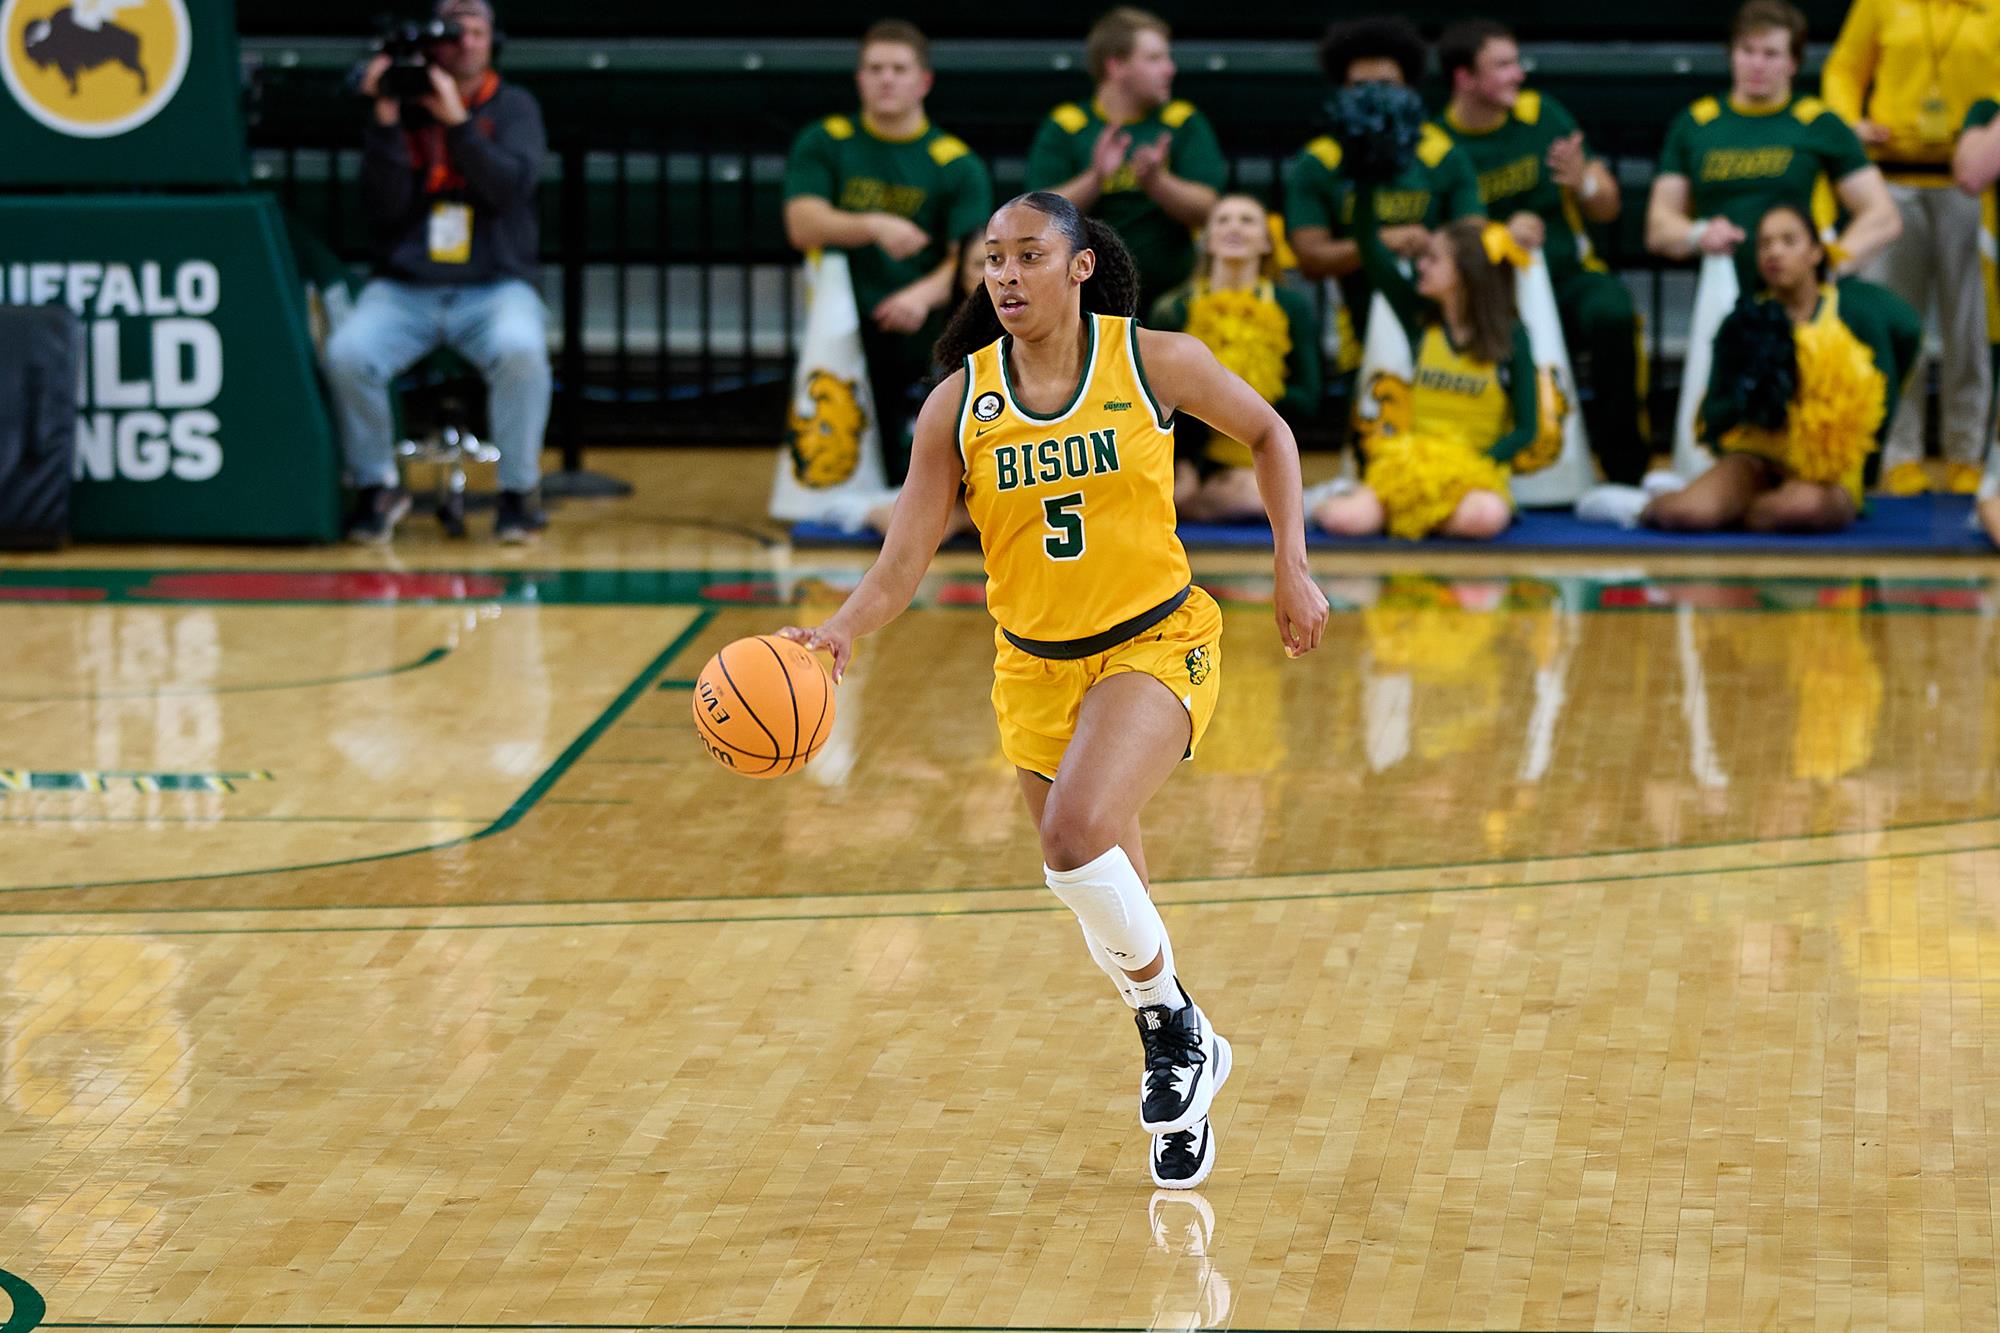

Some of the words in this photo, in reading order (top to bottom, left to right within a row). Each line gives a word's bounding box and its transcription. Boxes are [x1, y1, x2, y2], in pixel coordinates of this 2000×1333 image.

[0, 260, 220, 317] FFALO
[76, 318, 224, 409] LD
[72, 410, 224, 482] NGS
[995, 428, 1121, 492] BISON
[1041, 491, 1086, 562] 5
